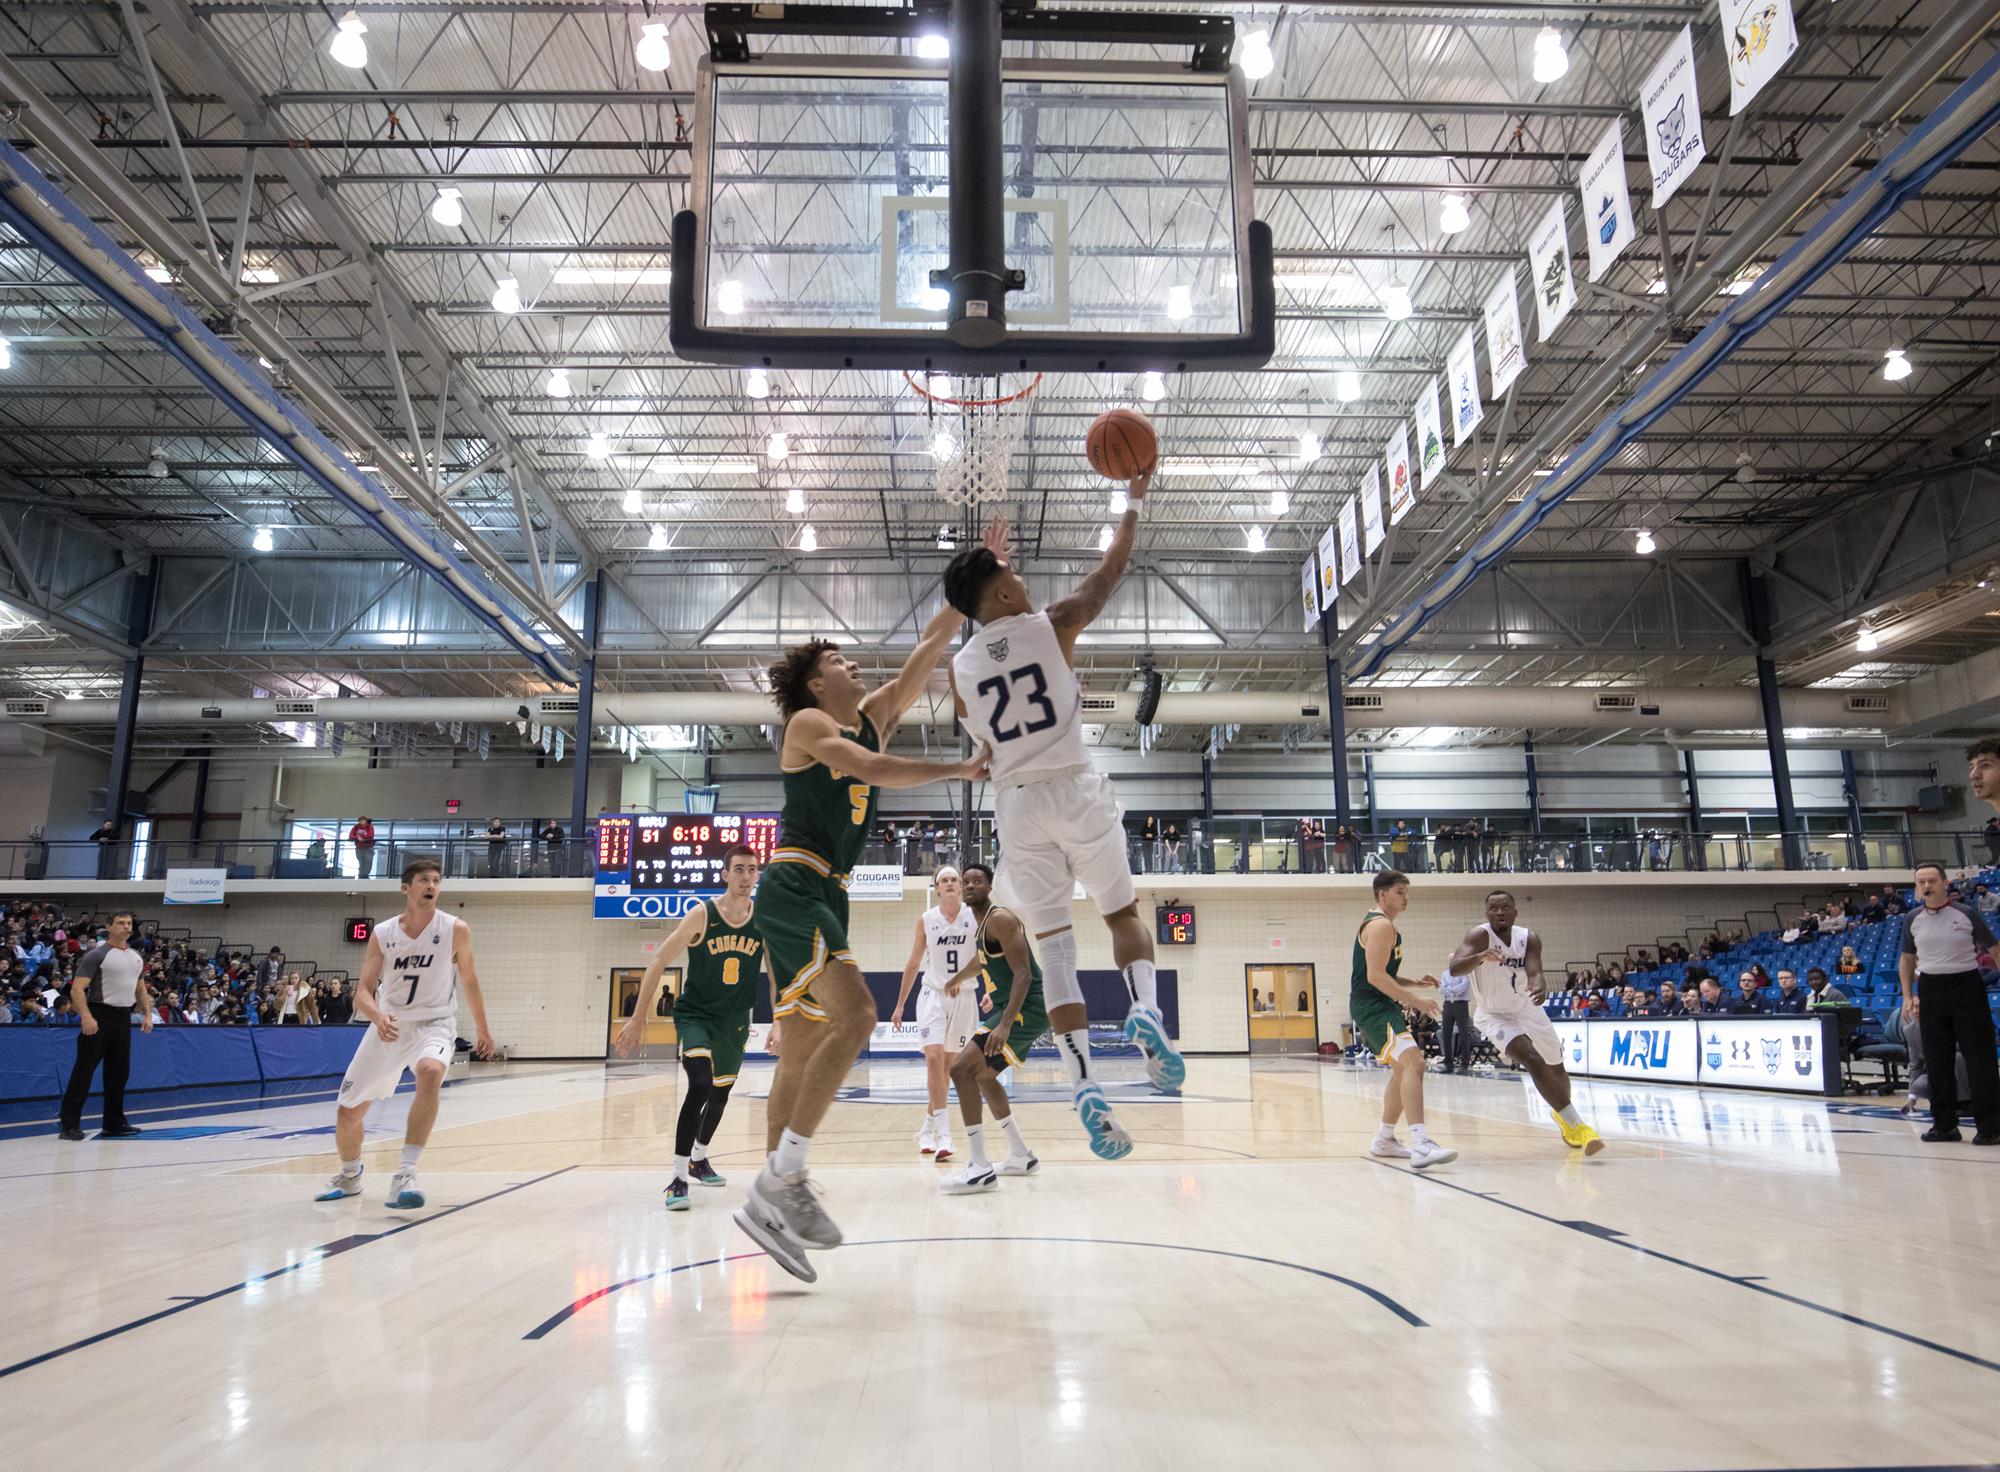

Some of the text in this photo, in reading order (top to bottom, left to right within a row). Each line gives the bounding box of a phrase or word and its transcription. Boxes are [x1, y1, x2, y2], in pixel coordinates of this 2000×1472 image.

[1647, 55, 1687, 110] MOUNT ROYAL
[1585, 142, 1618, 192] CANADA WEST
[1654, 134, 1700, 189] COUGARS
[977, 662, 1057, 743] 23
[848, 784, 870, 825] 5
[638, 816, 667, 828] MRU
[642, 825, 739, 843] 51 6:18 50
[695, 844, 703, 855] 3
[652, 860, 666, 869] TO
[671, 860, 708, 869] PLAYER
[710, 860, 724, 869] TO
[189, 878, 221, 888] Radiology
[638, 873, 645, 883] 1
[655, 873, 663, 883] 3
[713, 873, 721, 883] 3
[856, 873, 900, 881] COUGARS
[353, 924, 367, 939] 16
[1173, 926, 1187, 942] 16
[707, 935, 761, 957] COUGARS
[937, 935, 967, 946] MRU
[394, 954, 434, 970] MRU
[946, 950, 959, 974] 9
[722, 957, 740, 985] 8
[403, 975, 419, 1006] 7
[959, 1035, 967, 1048] 9
[1609, 1030, 1671, 1070] MRU
